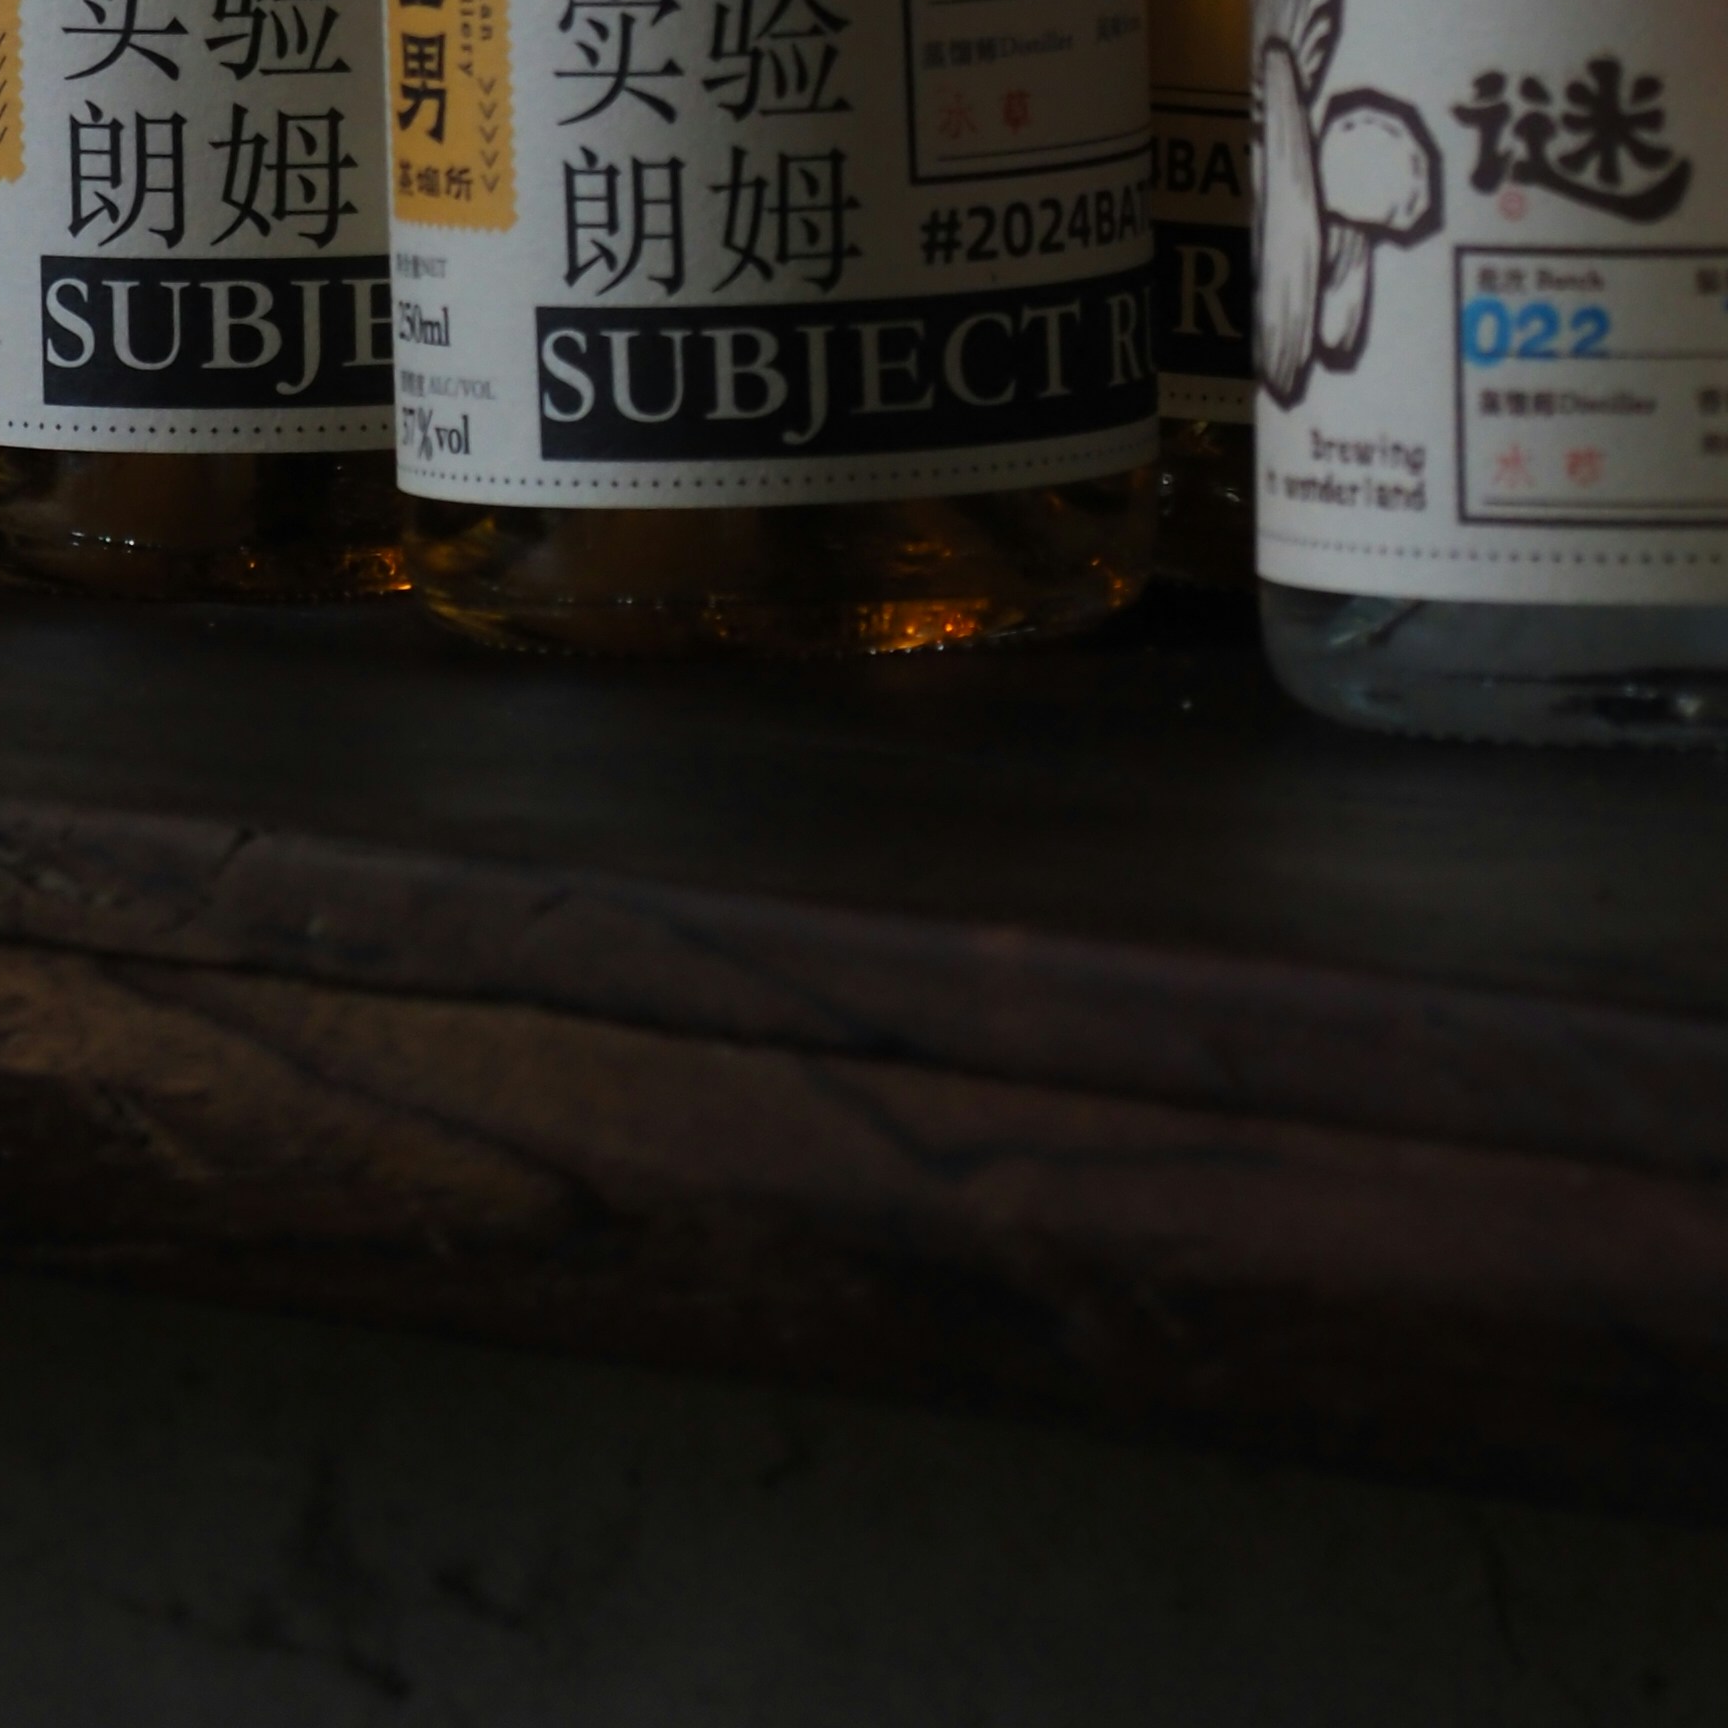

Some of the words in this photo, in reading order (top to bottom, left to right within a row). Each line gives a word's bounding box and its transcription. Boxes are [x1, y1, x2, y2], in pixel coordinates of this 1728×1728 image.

[67, 99, 359, 249] 朗姆
[1450, 55, 1692, 225] 谜
[560, 144, 862, 297] 朗姆
[542, 296, 1082, 447] SUBJECT
[1461, 295, 1611, 368] 022
